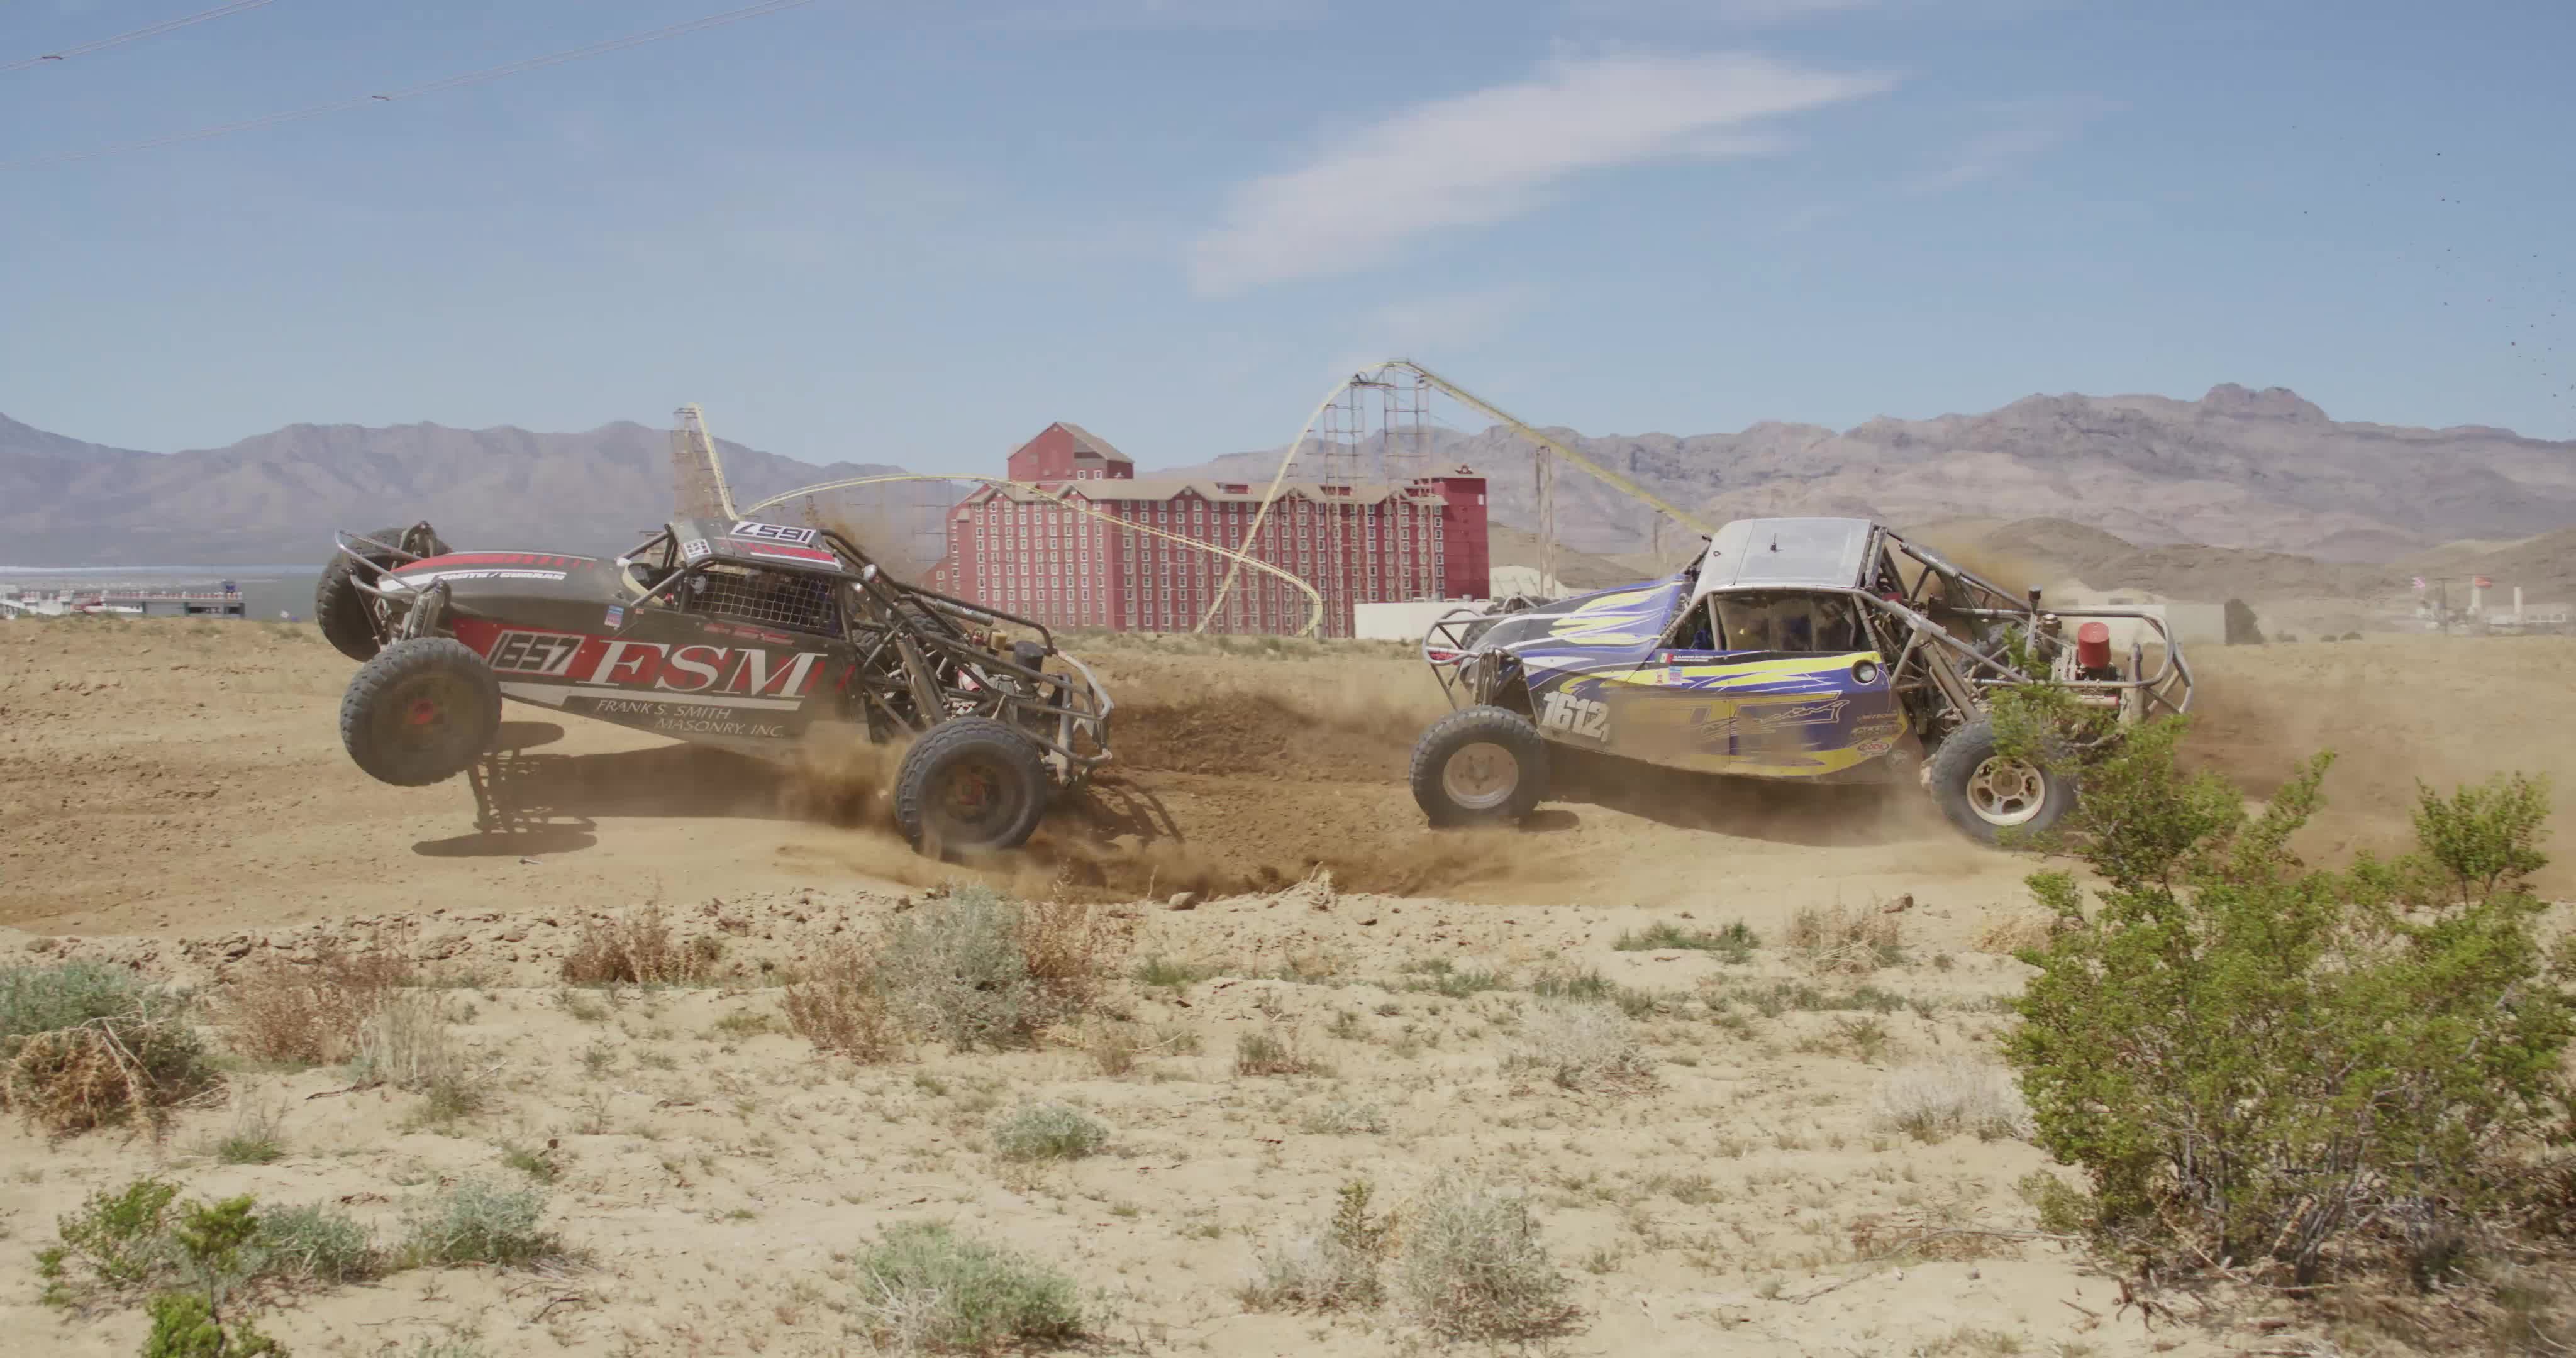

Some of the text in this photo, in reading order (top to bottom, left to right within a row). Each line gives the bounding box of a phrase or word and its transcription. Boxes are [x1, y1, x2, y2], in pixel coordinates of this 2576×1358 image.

[735, 523, 813, 541] 1657
[489, 631, 582, 673] 1657
[575, 639, 829, 698] FSM
[596, 699, 733, 720] FRANK S. SMITH
[1541, 690, 1609, 739] 1612
